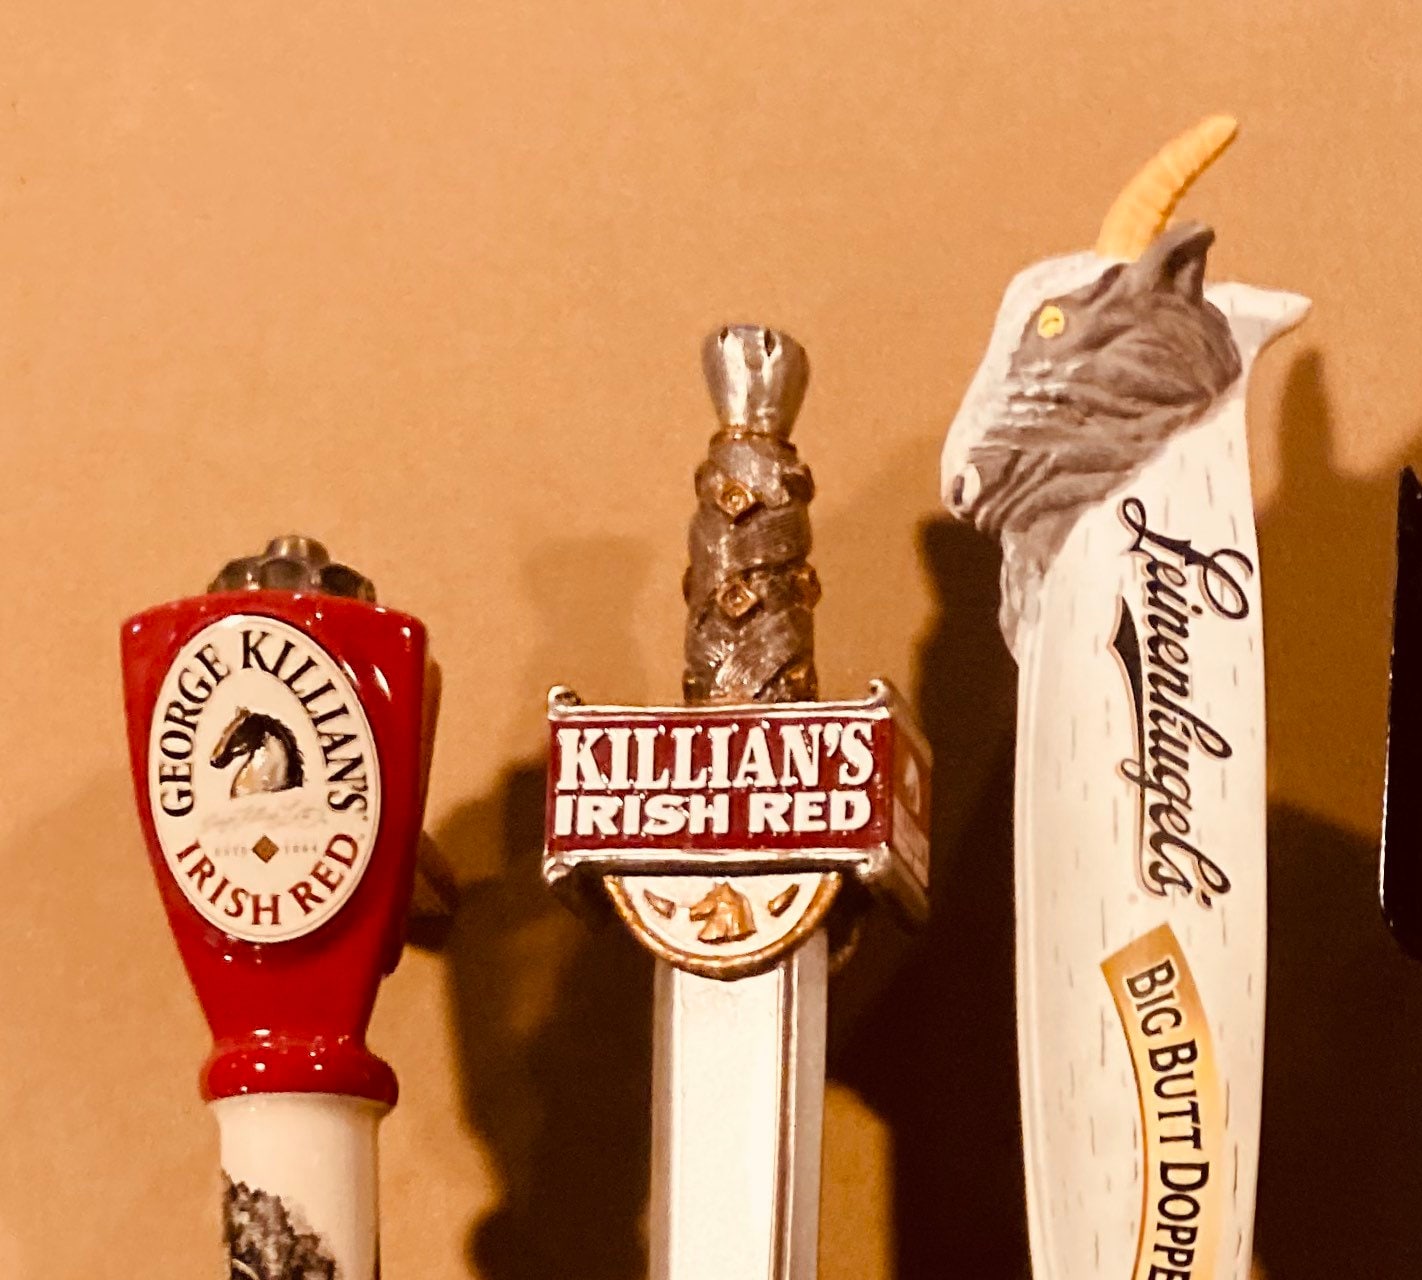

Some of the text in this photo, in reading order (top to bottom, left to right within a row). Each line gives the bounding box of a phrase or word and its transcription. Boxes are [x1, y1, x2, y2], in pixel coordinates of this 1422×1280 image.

[160, 629, 370, 818] GEORGE KILLIAN'S
[555, 720, 875, 792] KILLIAN'S
[554, 788, 873, 837] IRISH RED
[175, 833, 361, 926] IRISH RED
[1125, 958, 1183, 1038] BIG
[1147, 1037, 1204, 1151] BUTT
